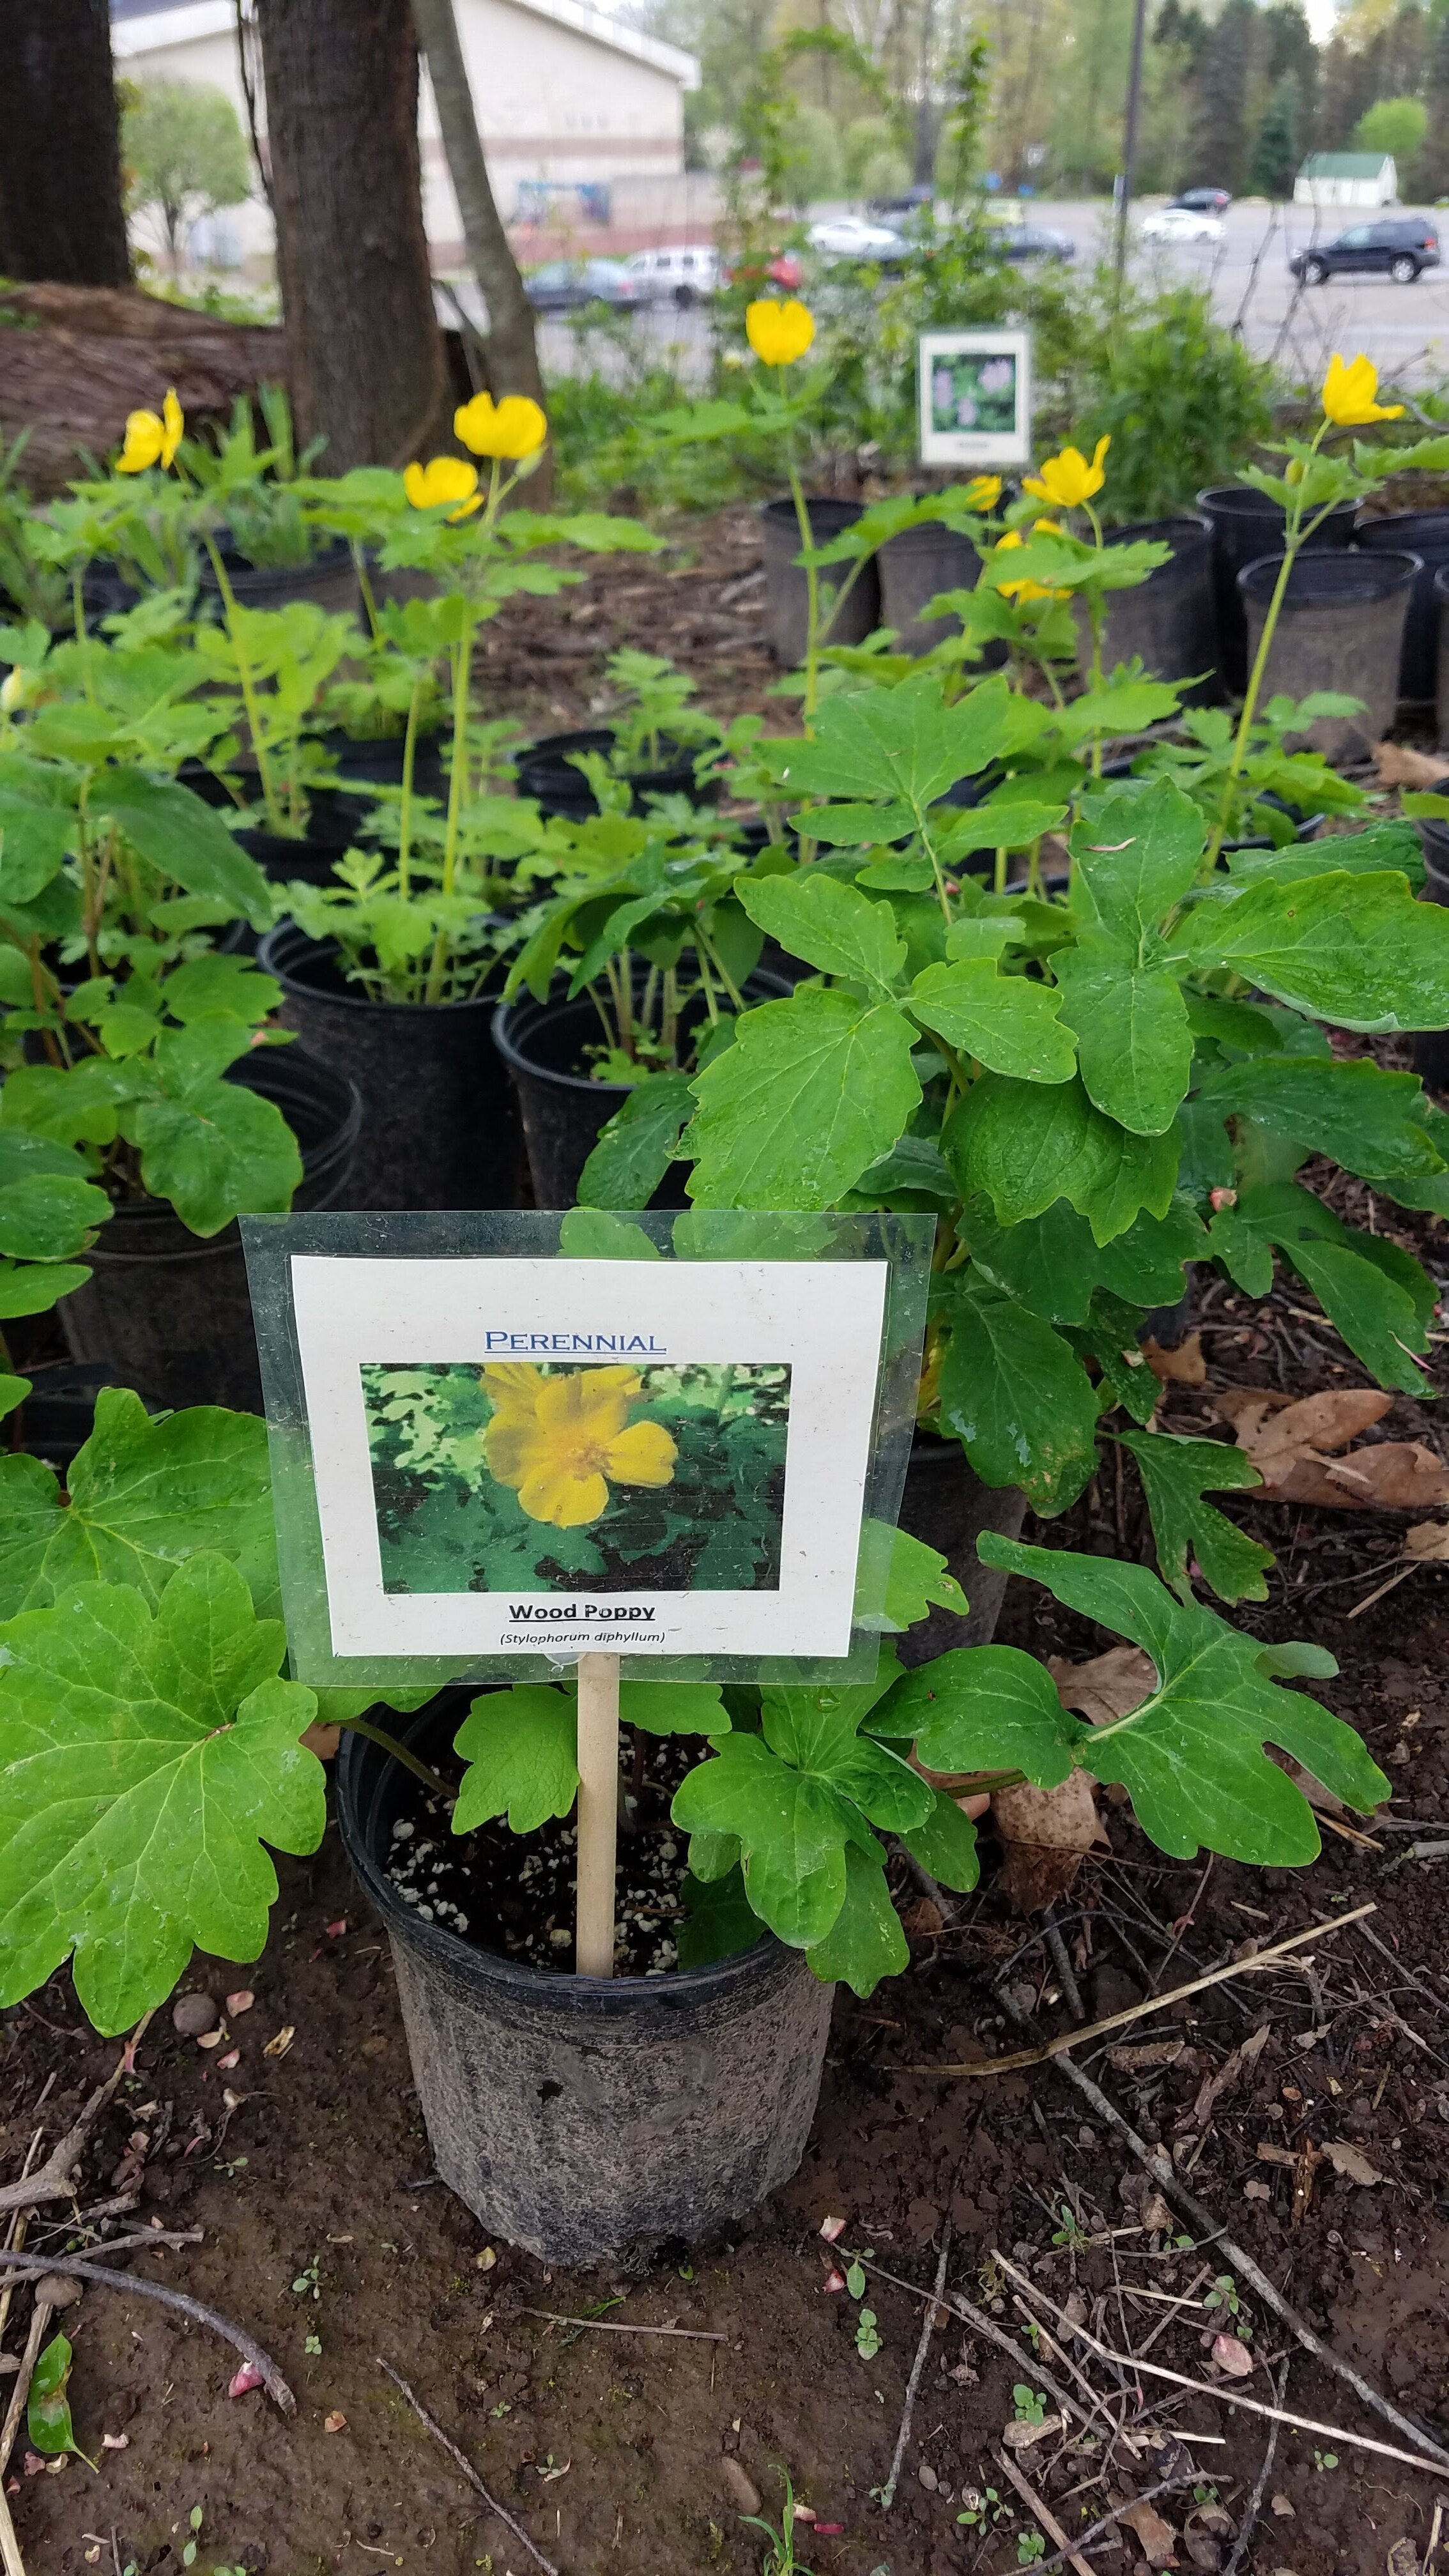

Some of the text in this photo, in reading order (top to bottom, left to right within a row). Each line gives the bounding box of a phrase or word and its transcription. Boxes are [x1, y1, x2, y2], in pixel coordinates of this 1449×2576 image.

[485, 1331, 667, 1351] PERENNIAL
[509, 1604, 656, 1621] Wood Poppy
[500, 1631, 666, 1645] (Stylophorum diphyllum)
